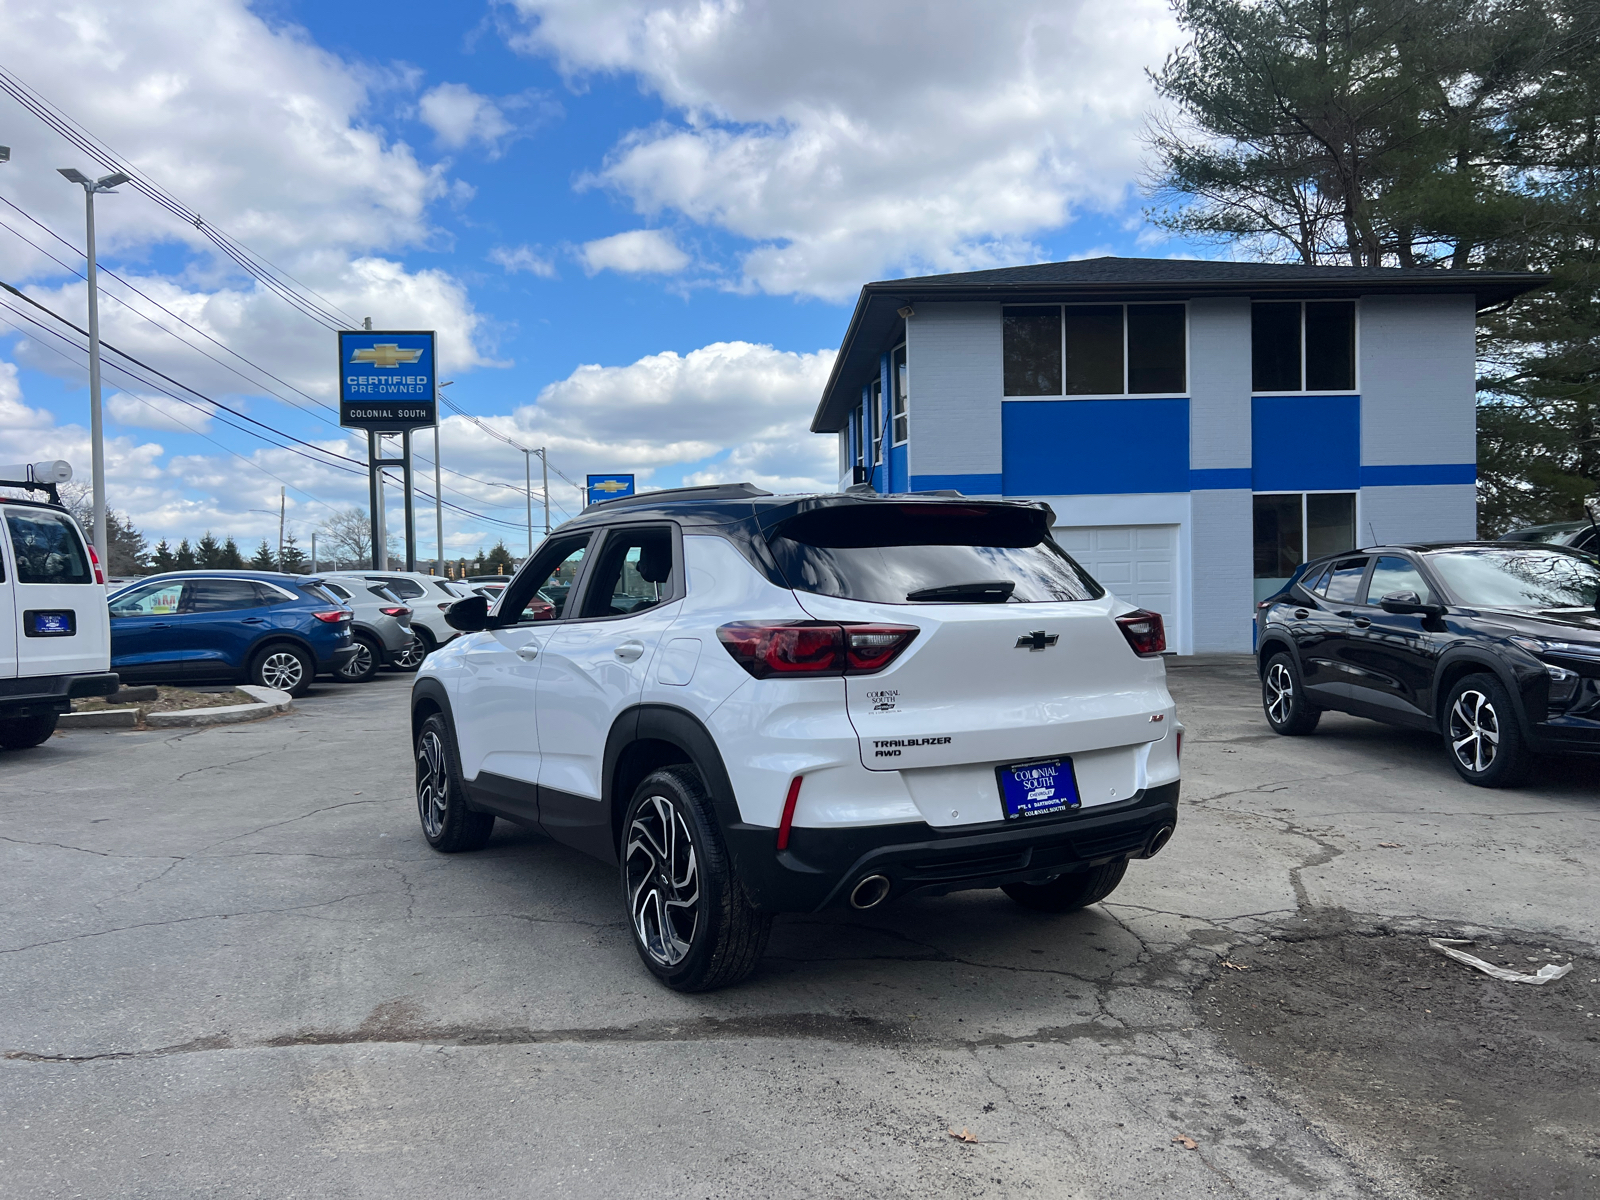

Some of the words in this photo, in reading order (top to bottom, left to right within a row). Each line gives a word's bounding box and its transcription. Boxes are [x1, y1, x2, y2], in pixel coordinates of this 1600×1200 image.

[347, 376, 427, 385] CERTIFIED
[351, 385, 424, 393] PRE-OWNED
[350, 409, 393, 418] COLONIAL
[398, 409, 426, 417] SOUTH
[866, 690, 900, 698] COLONIAL
[873, 736, 952, 748] TRAILBLAZER
[875, 749, 902, 757] AWD
[1014, 766, 1059, 781] COLONIAL
[1023, 777, 1055, 790] SOUTH
